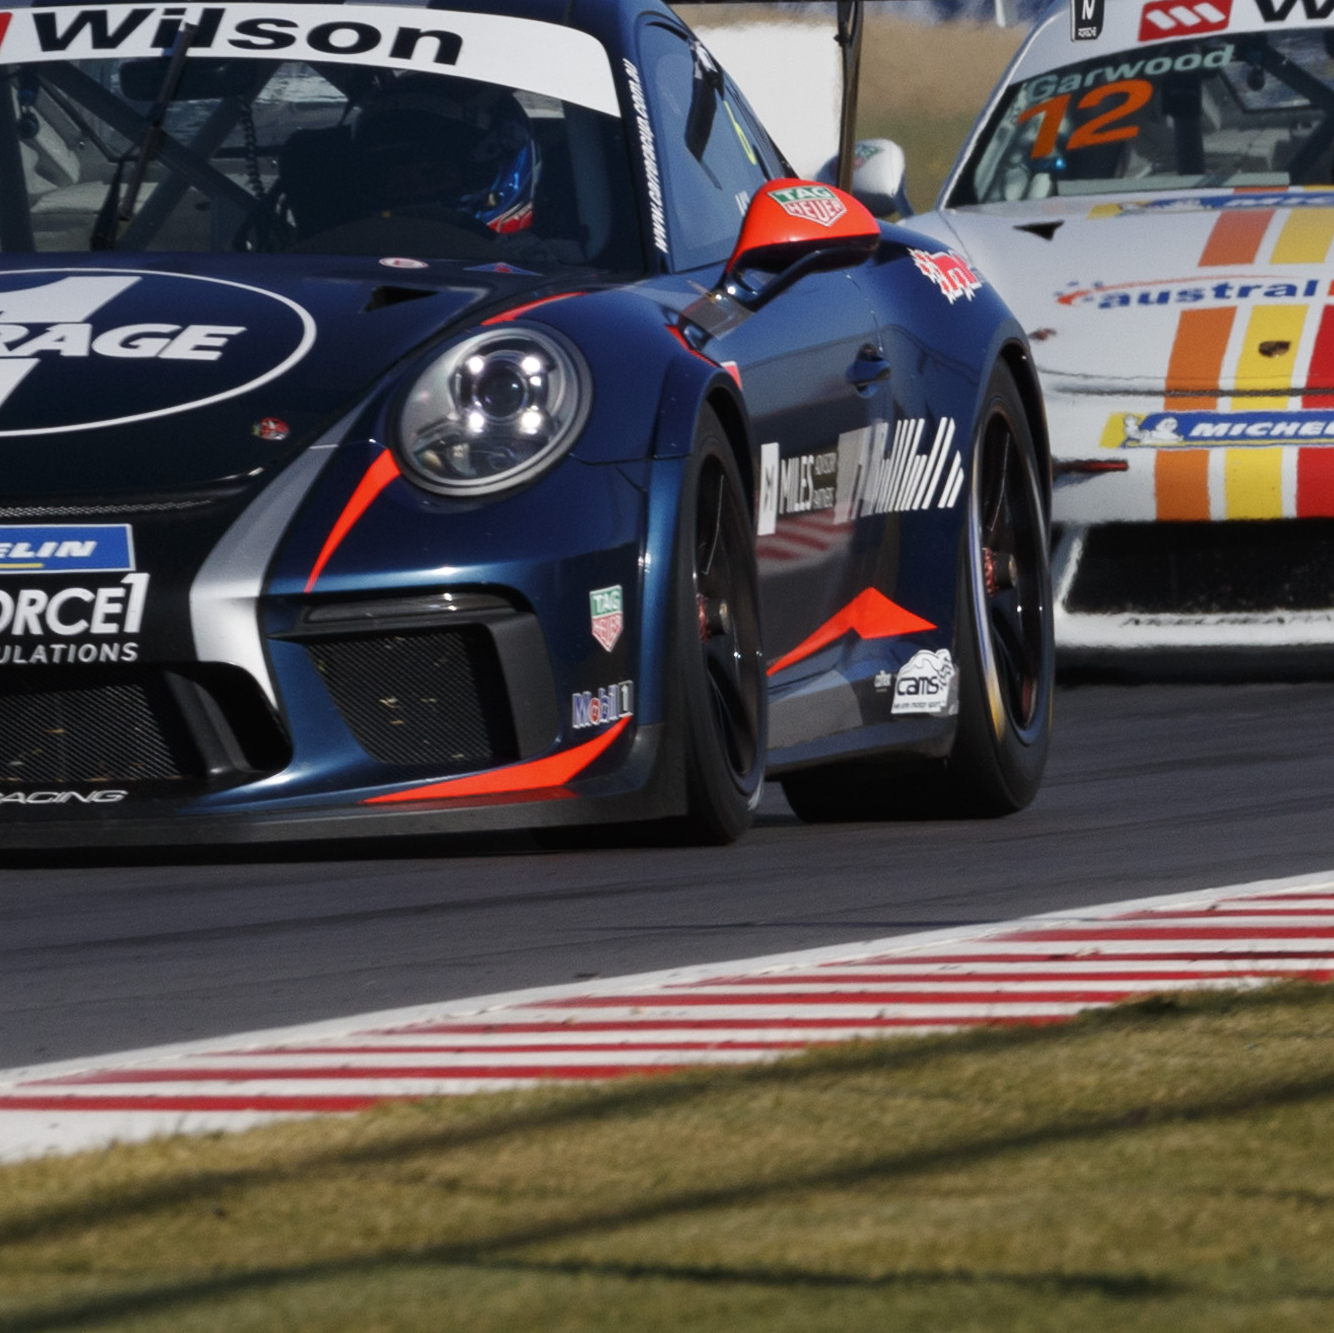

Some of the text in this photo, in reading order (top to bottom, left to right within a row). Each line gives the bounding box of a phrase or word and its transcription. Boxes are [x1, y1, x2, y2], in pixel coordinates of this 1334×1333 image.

[32, 6, 464, 66] Wilson
[1027, 44, 1235, 102] Garwood
[1019, 78, 1154, 160] 12
[777, 187, 828, 199] TAG
[788, 200, 842, 223] HEUER
[593, 591, 620, 613] TAG
[897, 676, 939, 696] cams
[572, 683, 618, 729] Mobil
